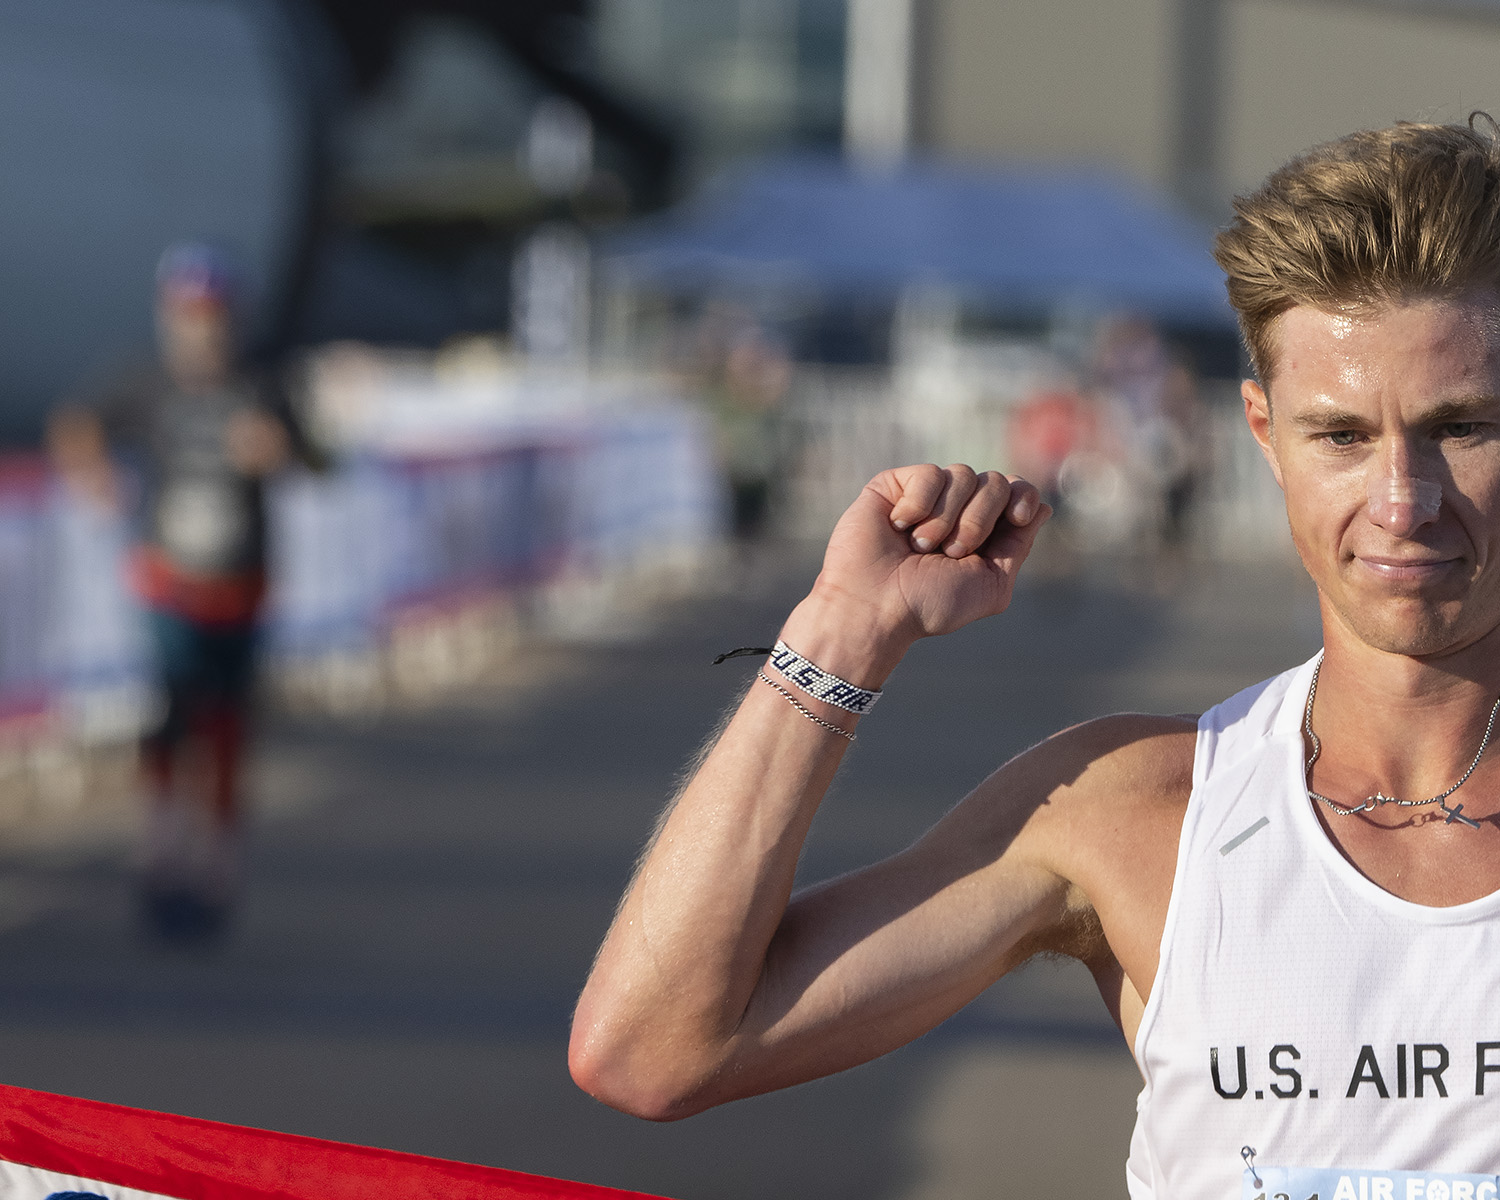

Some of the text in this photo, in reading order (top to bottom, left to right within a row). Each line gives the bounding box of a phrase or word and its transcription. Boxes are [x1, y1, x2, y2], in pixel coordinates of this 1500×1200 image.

[772, 650, 873, 712] U.S. AIR
[1210, 1044, 1318, 1100] U.S.
[1345, 1043, 1450, 1098] AIR
